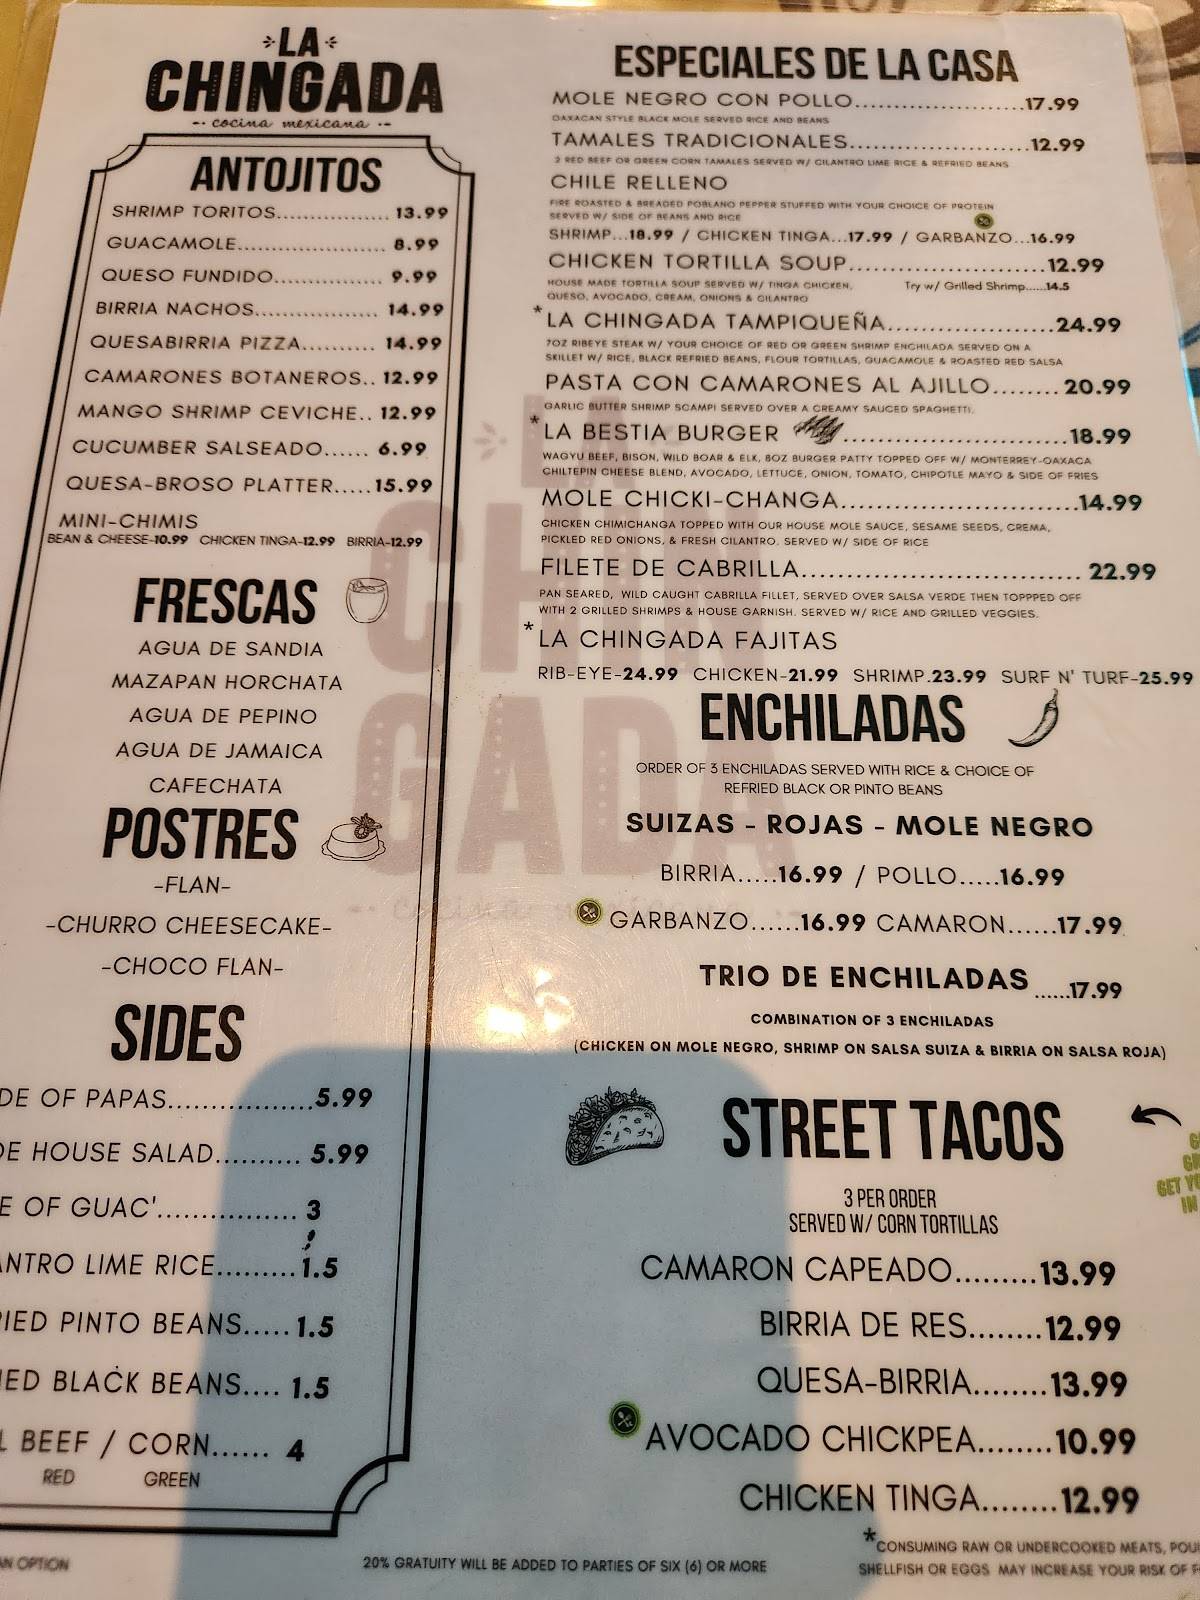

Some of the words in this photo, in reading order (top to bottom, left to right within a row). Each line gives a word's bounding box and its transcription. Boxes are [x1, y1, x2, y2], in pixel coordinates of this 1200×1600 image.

[278, 27, 320, 57] LA
[614, 45, 816, 79] ESPECIALES
[824, 48, 869, 80] DE
[876, 48, 921, 80] LA
[927, 49, 1019, 82] CASA
[145, 60, 444, 113] CHINGADA
[552, 90, 615, 106] MOLE
[625, 91, 707, 107] NEGRO
[716, 92, 769, 107] CON
[1025, 97, 1080, 111] 17.99
[211, 118, 273, 128] cocina
[282, 119, 369, 129] mexicana
[189, 157, 383, 193] ANTOJITOS
[550, 174, 616, 190] CHILE
[626, 174, 728, 191] RELLENO
[111, 205, 185, 218] SHRIMP
[396, 206, 449, 220] 13.99
[393, 237, 439, 251] 8.99
[548, 252, 653, 270] CHICKEN
[663, 253, 770, 271] TORTILLA
[1047, 257, 1105, 273] 12.99
[904, 280, 922, 293] Try
[943, 280, 983, 291] Grilled
[1045, 281, 1070, 291] 14.5
[89, 334, 231, 350] QUESABIRRIA
[386, 336, 442, 351] 14.99
[545, 373, 622, 391] PASTA
[632, 374, 689, 392] CON
[700, 375, 862, 393] CAMARONES
[871, 376, 900, 394] AL
[1064, 378, 1131, 395] 20.99
[77, 403, 163, 419] MANGO
[171, 404, 252, 420] SHRIMP
[380, 405, 437, 421] 12.99
[544, 422, 572, 440] LA
[583, 423, 667, 441] BESTIA
[678, 424, 778, 442] BURGER
[1069, 428, 1132, 445] 18.99
[66, 475, 234, 492] QUESA-BROSO
[375, 478, 433, 493] 15.99
[58, 513, 198, 530] MINI-CHIMIS
[47, 533, 81, 544] BEAN
[83, 533, 94, 545] &
[199, 534, 256, 546] CHICKEN
[541, 557, 620, 577] FILETE
[632, 558, 665, 577] DE
[677, 558, 799, 578] CABRILLA
[1088, 562, 1157, 581] 22.99
[133, 578, 318, 624] FRESCAS
[539, 589, 562, 598] PAN
[565, 589, 614, 600] SEARED,
[621, 590, 648, 599] WILD
[652, 590, 700, 600] CAUGHT
[704, 590, 758, 600] CABRILLA
[761, 591, 799, 601] FILLET,
[803, 591, 849, 601] SERVED
[851, 591, 884, 601] OVER
[888, 592, 925, 601] SALSA
[928, 592, 966, 602] VERDE
[970, 592, 999, 602] THEN
[1002, 592, 1056, 602] TOPPPED
[1058, 593, 1082, 603] OFF
[138, 639, 201, 656] AGUA
[209, 641, 237, 656] DE
[245, 641, 324, 657] SANDIA
[539, 628, 569, 648] LA
[579, 629, 724, 650] CHINGADA
[735, 631, 837, 651] FAJITAS
[111, 673, 216, 690] MAZAPAN
[225, 674, 343, 691] HORCHATA
[700, 693, 966, 742] ENCHILADAS
[149, 777, 282, 795] CAFECHATA
[724, 782, 779, 794] REFRIED
[783, 782, 826, 795] BLACK
[829, 783, 851, 795] OR
[854, 783, 894, 795] PINTO
[898, 783, 943, 796] BEANS
[101, 807, 299, 860] POSTRES
[626, 812, 734, 834] SUIZAS
[767, 814, 863, 836] ROJAS
[895, 815, 979, 836] MOLE
[990, 816, 1093, 838] NEGRO
[699, 964, 770, 987] TRIO
[782, 965, 818, 988] DE
[830, 965, 1029, 991] ENCHILADAS
[1069, 981, 1123, 1000] 17.99
[750, 1013, 857, 1026] COMBINATION
[861, 1013, 882, 1027] OF
[886, 1014, 895, 1026] 3
[899, 1015, 994, 1028] ENCHILADAS
[110, 1004, 245, 1062] SIDES
[722, 1098, 897, 1159] STREET
[908, 1100, 1064, 1161] TACOS
[843, 1187, 854, 1208] 3
[857, 1188, 886, 1208] PER
[888, 1188, 937, 1209] ORDER
[788, 1212, 846, 1233] SERVED
[849, 1213, 873, 1233] W/
[877, 1213, 917, 1234] CORN
[919, 1214, 999, 1235] TORTILLAS
[85, 1253, 144, 1276] LIME
[302, 1256, 338, 1279] 1.5
[60, 1311, 140, 1334] PINTO
[153, 1311, 241, 1336] BEANS
[297, 1315, 334, 1338] 1.5
[760, 1311, 851, 1336] BIRRIA
[861, 1312, 899, 1337] DE
[1045, 1316, 1121, 1341] 12.99
[42, 1468, 76, 1487] RED
[143, 1470, 201, 1489] GREEN
[739, 1483, 875, 1512] CHICKEN
[1060, 1486, 1140, 1514] 12.99
[875, 1540, 958, 1554] CONSUMING
[961, 1540, 990, 1554] RAW
[993, 1540, 1013, 1554] OR
[1016, 1540, 1117, 1555] UNDERCOOKED
[1119, 1540, 1167, 1556] MEATS,
[362, 1555, 390, 1570] 20%
[394, 1556, 457, 1570] GRATUITY
[460, 1557, 488, 1571] WILL
[491, 1557, 507, 1572] BE
[511, 1558, 557, 1572] ADDED
[560, 1558, 579, 1572] TO
[582, 1559, 634, 1573] PARTIES
[637, 1559, 657, 1573] OF
[659, 1559, 681, 1574] SIX
[684, 1559, 703, 1576] (6)
[705, 1559, 726, 1573] OR
[728, 1559, 767, 1574] MORE
